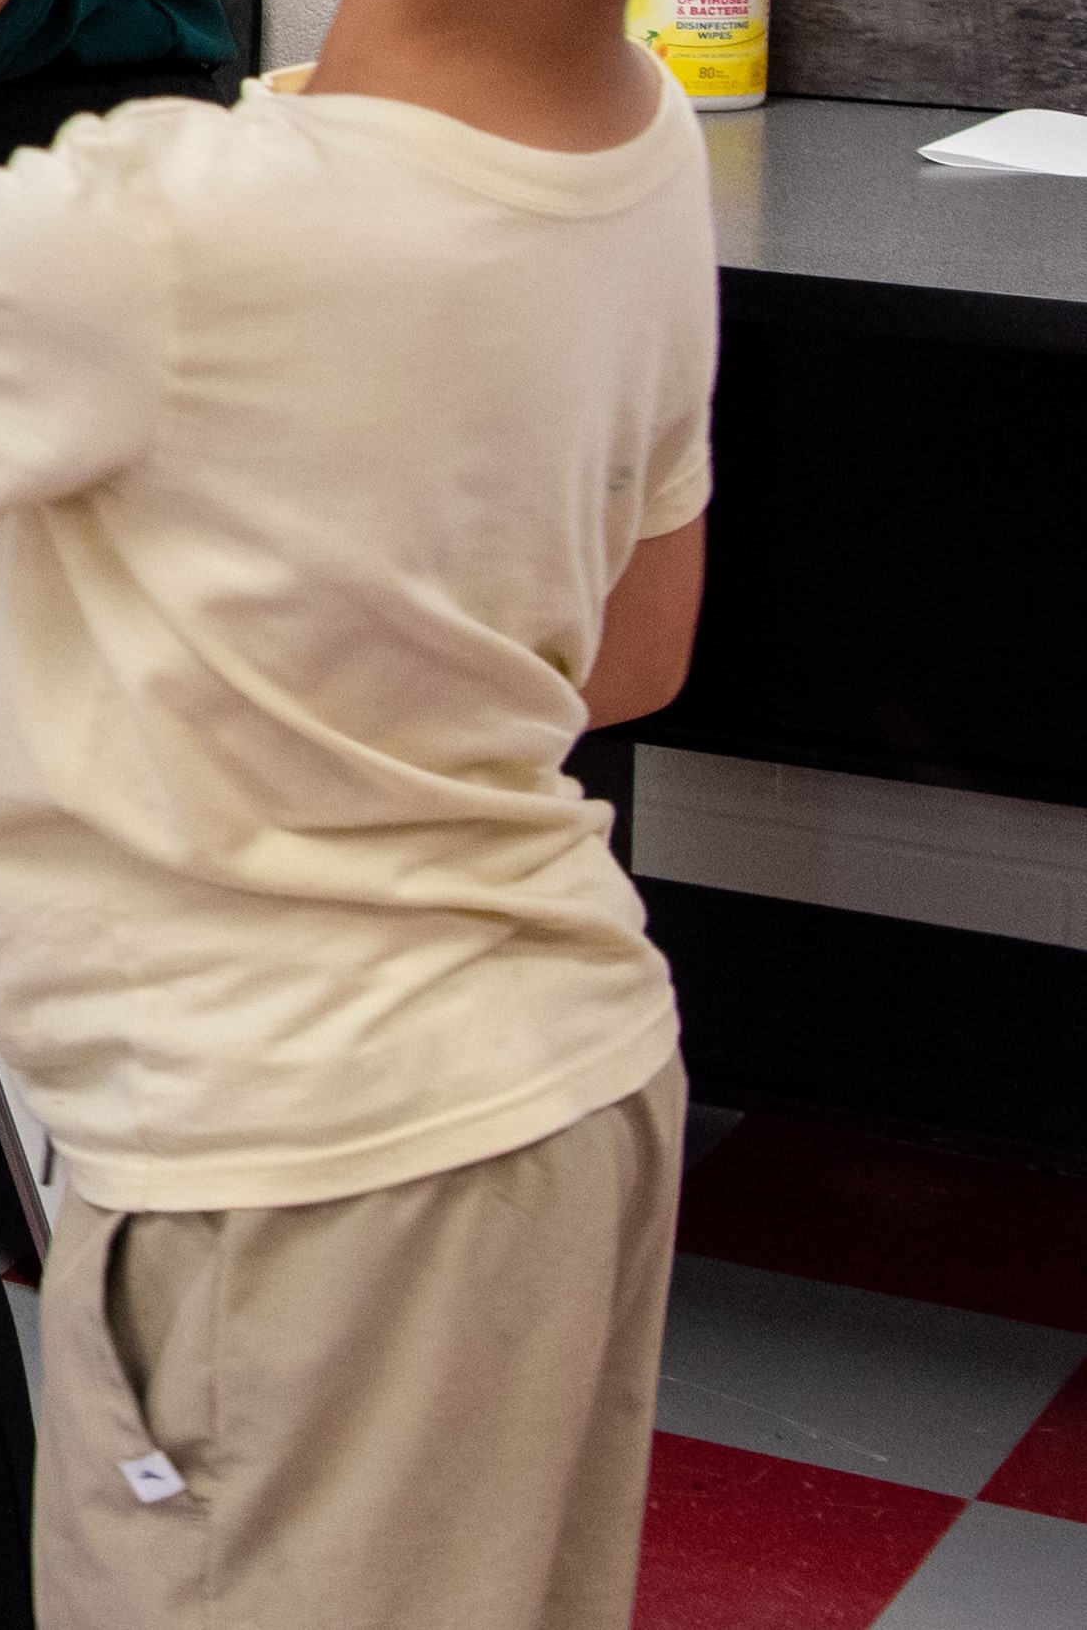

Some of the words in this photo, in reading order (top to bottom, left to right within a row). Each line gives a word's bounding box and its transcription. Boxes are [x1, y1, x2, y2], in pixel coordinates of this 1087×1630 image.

[677, 6, 685, 15] &
[676, 21, 749, 29] DISINFECTING
[698, 32, 732, 40] WIPES
[699, 66, 715, 79] 80
